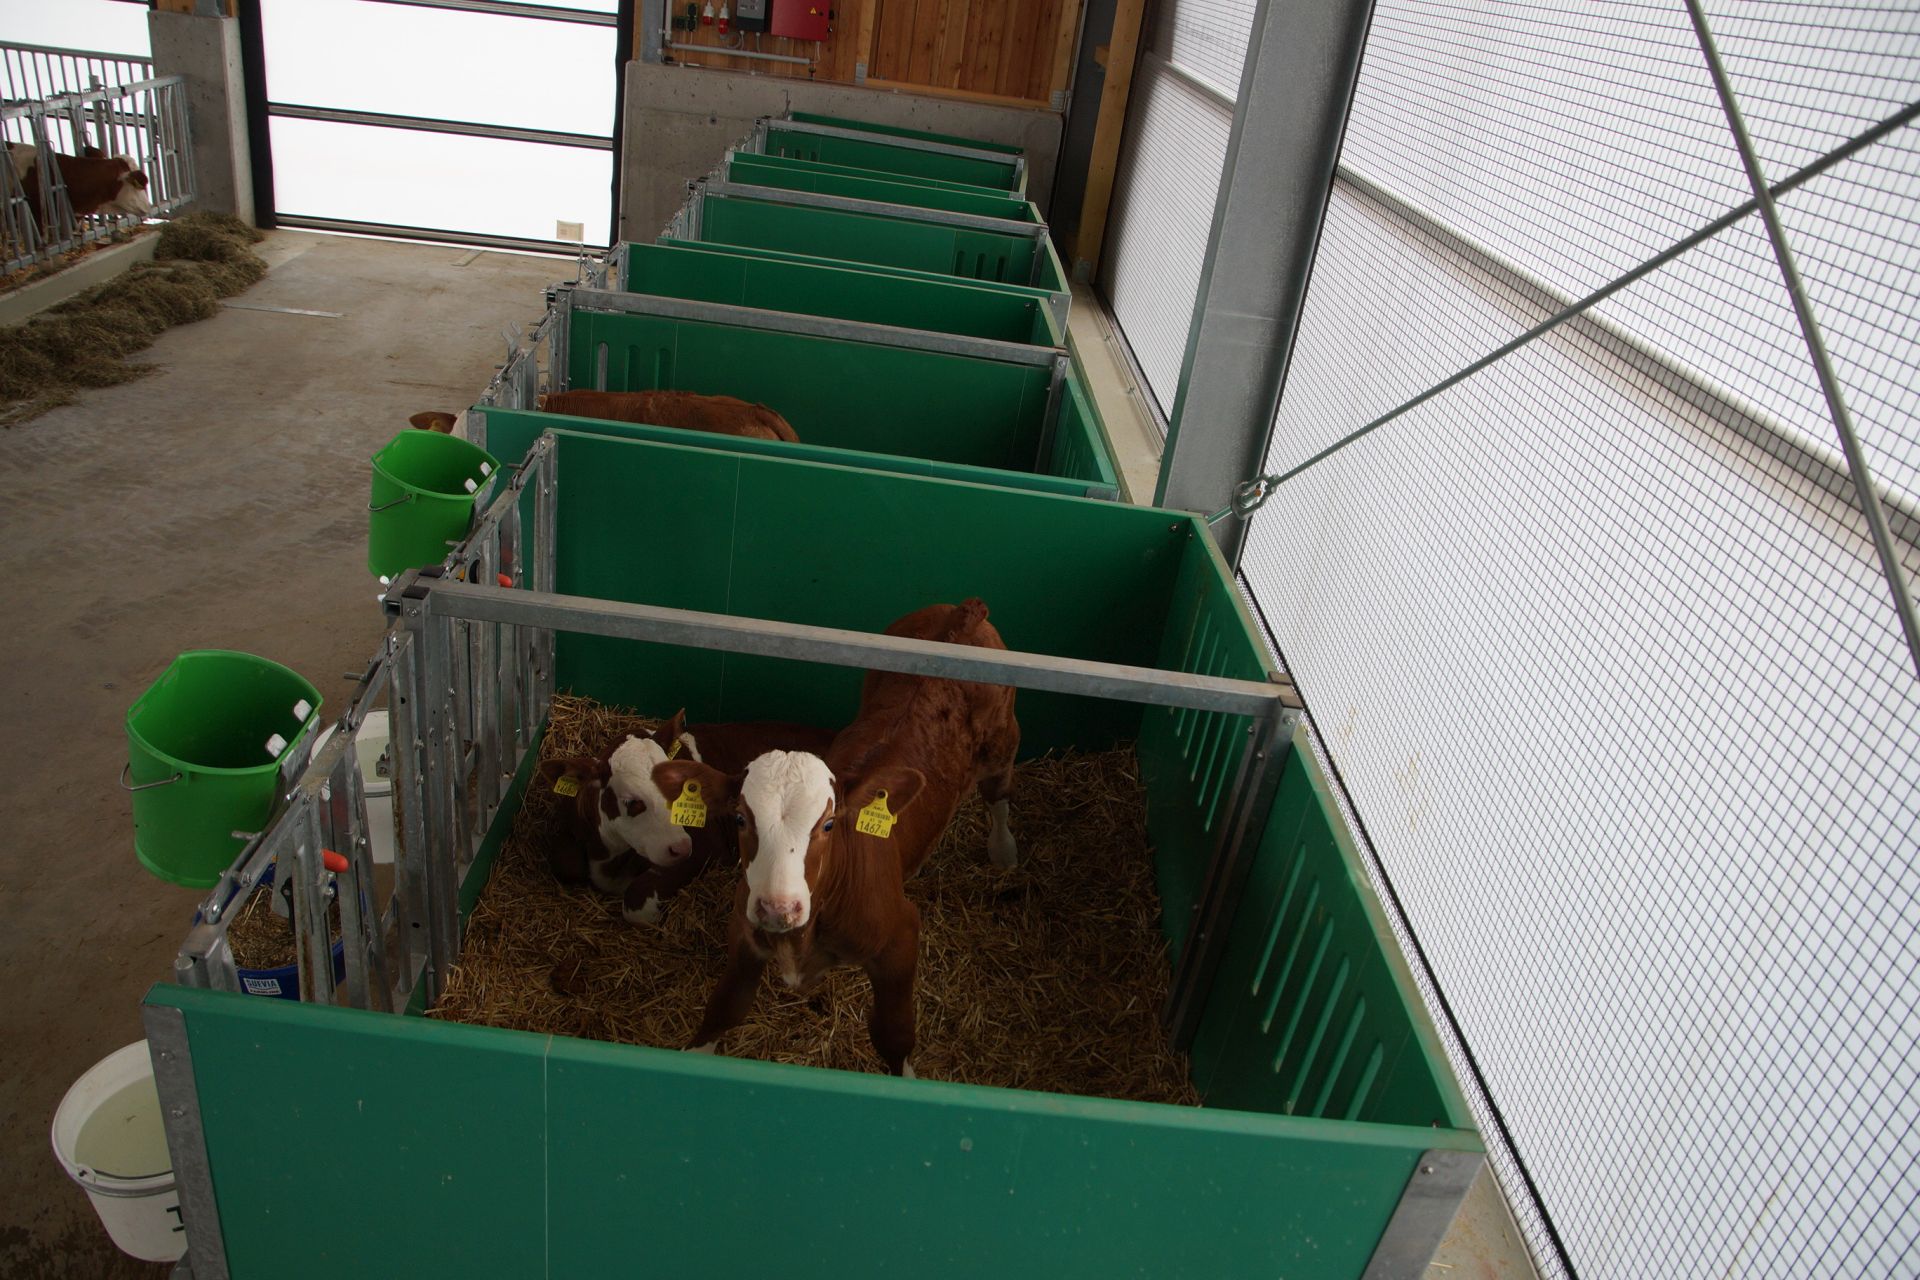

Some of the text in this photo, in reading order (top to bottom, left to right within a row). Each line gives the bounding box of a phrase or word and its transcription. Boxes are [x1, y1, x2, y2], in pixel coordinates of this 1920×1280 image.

[674, 813, 697, 825] 1467
[860, 820, 881, 834] 1467
[246, 979, 277, 988] SUEVIA
